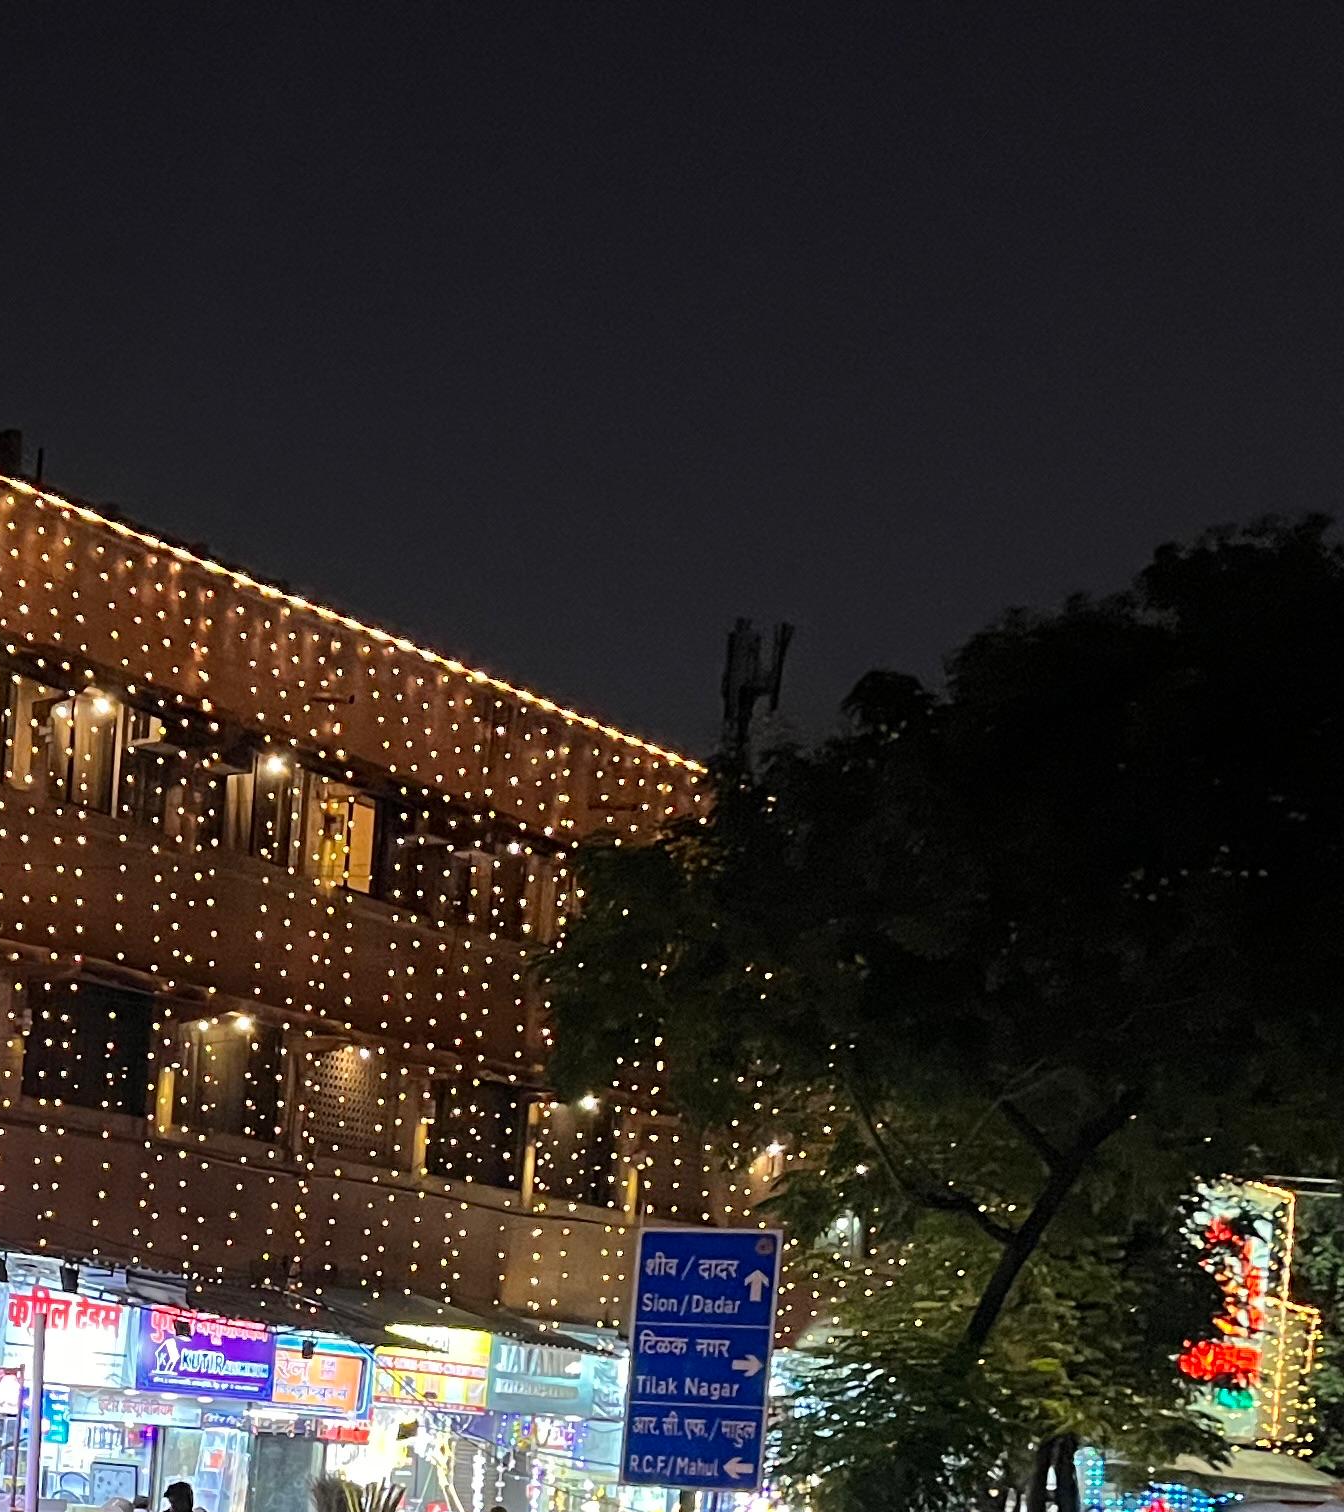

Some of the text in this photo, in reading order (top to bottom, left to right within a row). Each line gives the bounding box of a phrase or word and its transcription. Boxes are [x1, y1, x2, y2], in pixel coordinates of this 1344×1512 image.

[644, 1252, 679, 1277] शीव
[699, 1259, 740, 1281] दादर
[642, 1293, 679, 1313] Sion
[691, 1295, 742, 1315] Dadar
[638, 1328, 731, 1359] टिळक नगर
[180, 1348, 225, 1375] KUTIR
[636, 1374, 740, 1401] Tilak Nagar
